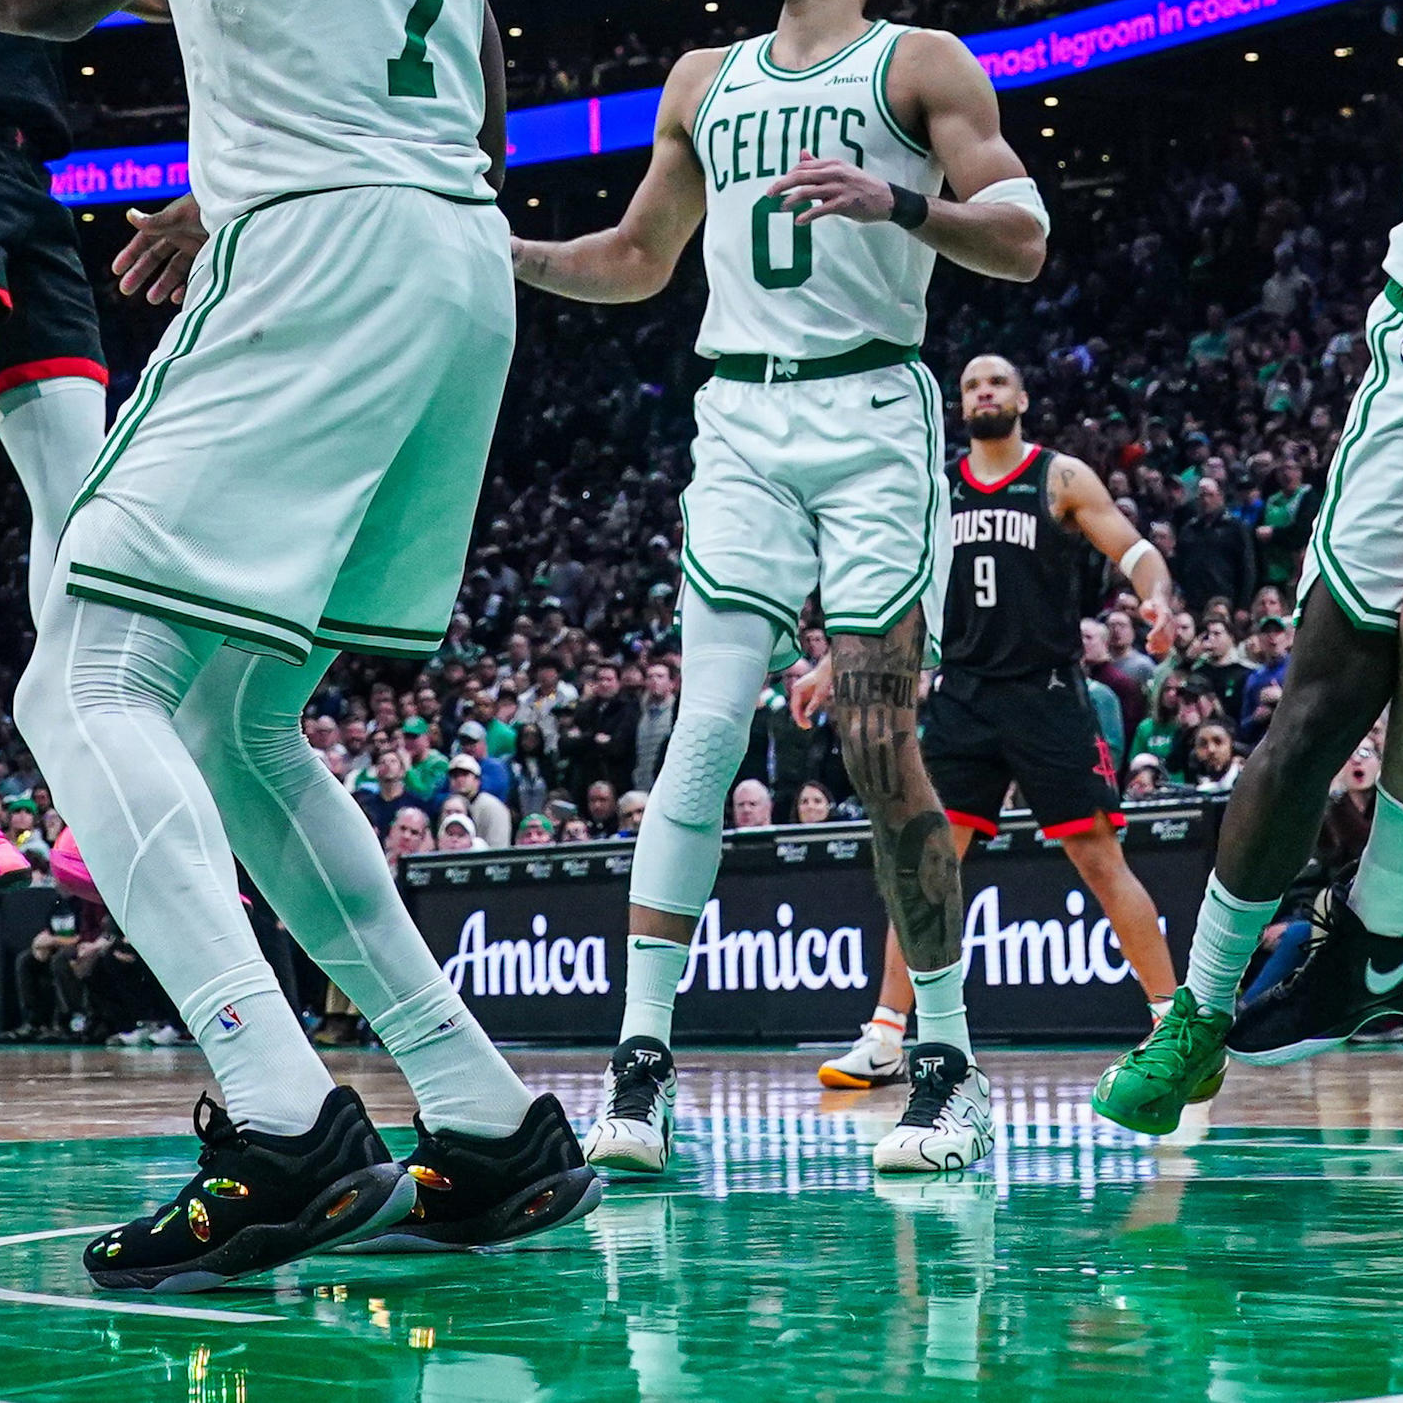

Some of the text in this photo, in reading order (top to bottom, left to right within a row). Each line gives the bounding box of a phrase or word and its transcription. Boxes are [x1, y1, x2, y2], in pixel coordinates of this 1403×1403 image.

[1049, 13, 1155, 68] legroom
[1157, 1, 1184, 35] in
[111, 159, 163, 190] the
[752, 195, 813, 290] 0
[974, 555, 998, 608] 9
[445, 910, 609, 996] Amica
[678, 899, 867, 991] Amica
